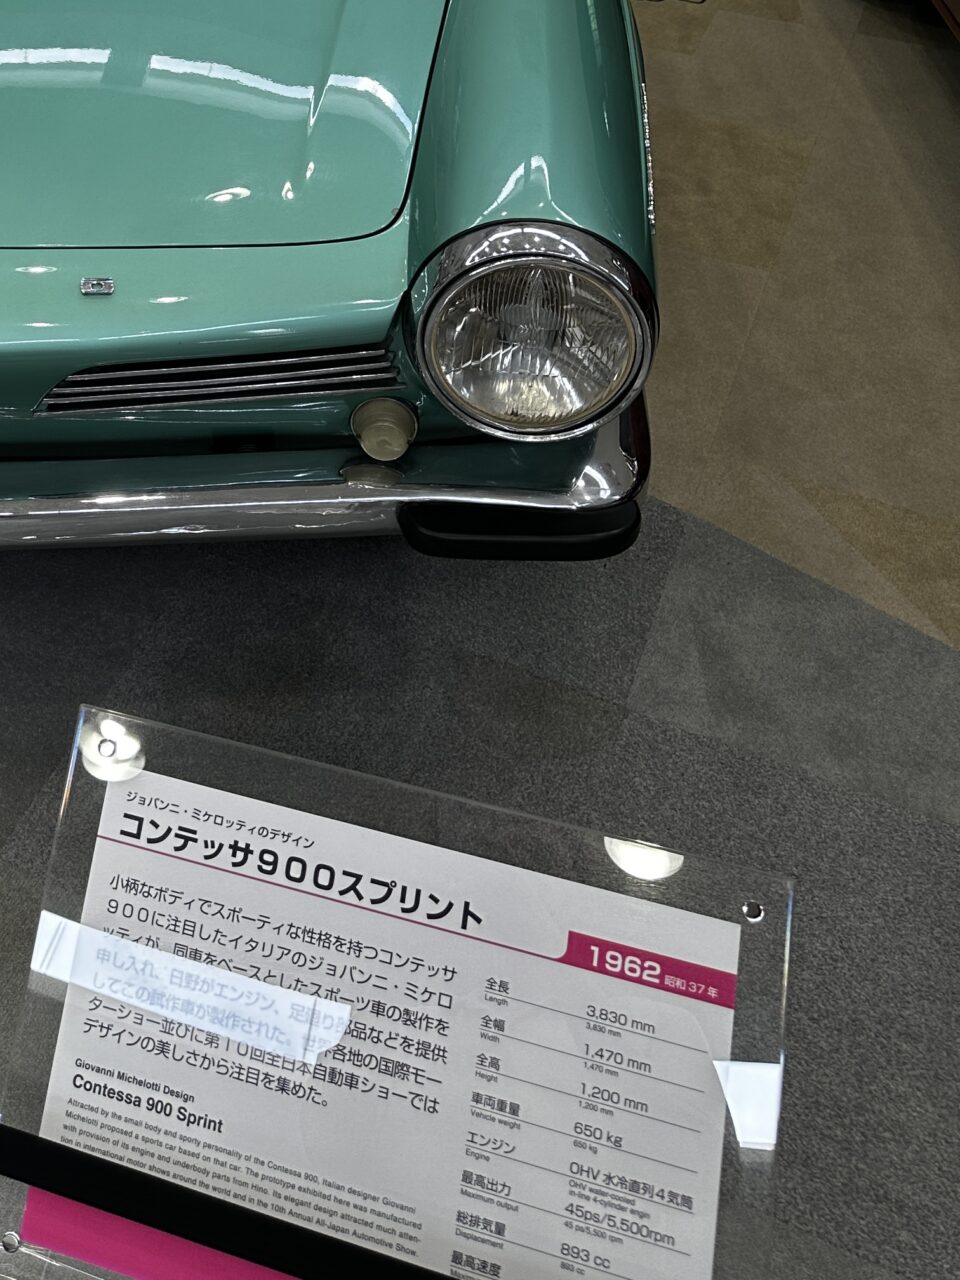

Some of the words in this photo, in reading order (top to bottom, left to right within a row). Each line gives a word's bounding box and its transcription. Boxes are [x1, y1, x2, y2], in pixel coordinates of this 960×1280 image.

[126, 791, 315, 848] ジョバンニ・ミケロッティのデザイン
[119, 812, 482, 930] コンテッサ900スプリント
[109, 874, 457, 982] 小柄なボディでスポーティな性格を持つコンテッサ
[106, 898, 453, 1010] 900に注目したイタリアのジョバンニ・ミケロ
[590, 945, 661, 983] 1962
[100, 921, 451, 1038] ッティが同車をベースとしたスポーツ車の製作を
[484, 976, 509, 994] 全長
[484, 993, 508, 1006] Length
[480, 1014, 505, 1032] 全幅
[585, 1021, 606, 1034] 3,830
[607, 1028, 622, 1038] mm
[586, 1004, 627, 1026] 3,830
[630, 1019, 655, 1034] mm
[479, 1031, 500, 1043] Width
[83, 1017, 328, 1107] デザインの美しさから注目を集めた。
[475, 1052, 500, 1071] 全高
[584, 1043, 623, 1065] 1,470
[626, 1058, 651, 1073] mm
[74, 1057, 115, 1077] Giovanni
[116, 1070, 161, 1092] Michelotti
[162, 1084, 195, 1103] Design
[474, 1069, 498, 1083] Height
[604, 1068, 619, 1077] mm
[72, 1073, 141, 1108] Contessa
[145, 1096, 173, 1117] 900
[176, 1106, 223, 1133] Sprint
[470, 1091, 520, 1117] 車両重量
[578, 1100, 598, 1112] 1,200
[599, 1107, 614, 1117] mm
[581, 1082, 620, 1105] 1,200
[623, 1097, 648, 1113] mm
[470, 1108, 496, 1123] Vehicle
[494, 1118, 521, 1130] weight
[465, 1130, 516, 1154] エンジン
[572, 1139, 587, 1150] 650
[588, 1144, 598, 1155] kg
[573, 1121, 603, 1140] 650
[606, 1130, 623, 1148] kg
[66, 1097, 99, 1114] Attracted
[100, 1107, 109, 1118] by
[110, 1111, 122, 1121] the
[123, 1116, 143, 1127] small
[143, 1121, 162, 1135] body
[163, 1129, 177, 1138] and
[178, 1133, 201, 1147] sporty
[202, 1141, 242, 1160] personality
[243, 1154, 252, 1162] of
[253, 1156, 265, 1166] the
[266, 1160, 302, 1178] Contessa
[303, 1172, 320, 1185] 900,
[322, 1178, 345, 1191] Italian
[346, 1186, 380, 1202] designer
[381, 1196, 416, 1214] Giovanni
[464, 1147, 490, 1162] Engine
[62, 1123, 77, 1133] with
[78, 1128, 110, 1144] provision
[111, 1139, 120, 1147] of
[120, 1141, 129, 1150] its
[130, 1145, 155, 1158] engine
[156, 1153, 171, 1163] and
[172, 1159, 210, 1177] underbody
[211, 1171, 230, 1183] parts
[232, 1176, 249, 1189] from
[250, 1182, 268, 1195] Hino.
[272, 1189, 282, 1199] Its
[283, 1194, 311, 1209] elegant
[312, 1203, 338, 1218] design
[339, 1212, 374, 1229] attracted
[375, 1223, 397, 1236] much
[398, 1231, 421, 1243] atten-
[64, 1109, 98, 1127] Michelotti
[99, 1122, 133, 1138] proposed
[140, 1135, 163, 1148] sports
[164, 1142, 176, 1151] car
[177, 1145, 200, 1159] based
[201, 1154, 211, 1163] on
[212, 1157, 227, 1168] that
[228, 1163, 241, 1172] car.
[245, 1166, 259, 1178] The
[260, 1173, 296, 1190] prototype
[297, 1185, 332, 1201] exhibited
[332, 1195, 351, 1208] here
[352, 1203, 368, 1213] was
[369, 1208, 422, 1230] manufactured
[460, 1169, 511, 1196] 最高出力
[569, 1161, 600, 1180] OHV
[60, 1135, 73, 1145] tion
[74, 1139, 81, 1148] in
[82, 1143, 125, 1162] international
[126, 1157, 147, 1169] motor
[148, 1164, 170, 1177] shows
[171, 1172, 197, 1185] around
[198, 1179, 210, 1190] the
[211, 1185, 231, 1197] world
[232, 1191, 246, 1202] and
[256, 1198, 268, 1208] the
[270, 1202, 286, 1214] 10th
[287, 1208, 314, 1223] Annual
[314, 1217, 350, 1234] All-Japan
[351, 1229, 393, 1249] Automotive
[395, 1242, 419, 1256] Show.
[568, 1179, 587, 1191] OHV
[459, 1187, 495, 1204] Maximum
[495, 1200, 519, 1212] output
[455, 1209, 506, 1237] 総排気量
[563, 1220, 574, 1229] 45
[564, 1202, 675, 1246] 45ps/5,500rpm
[454, 1227, 504, 1250] Displacement
[450, 1249, 501, 1278] 最高速度
[560, 1242, 590, 1262] 893
[593, 1255, 610, 1269] cc
